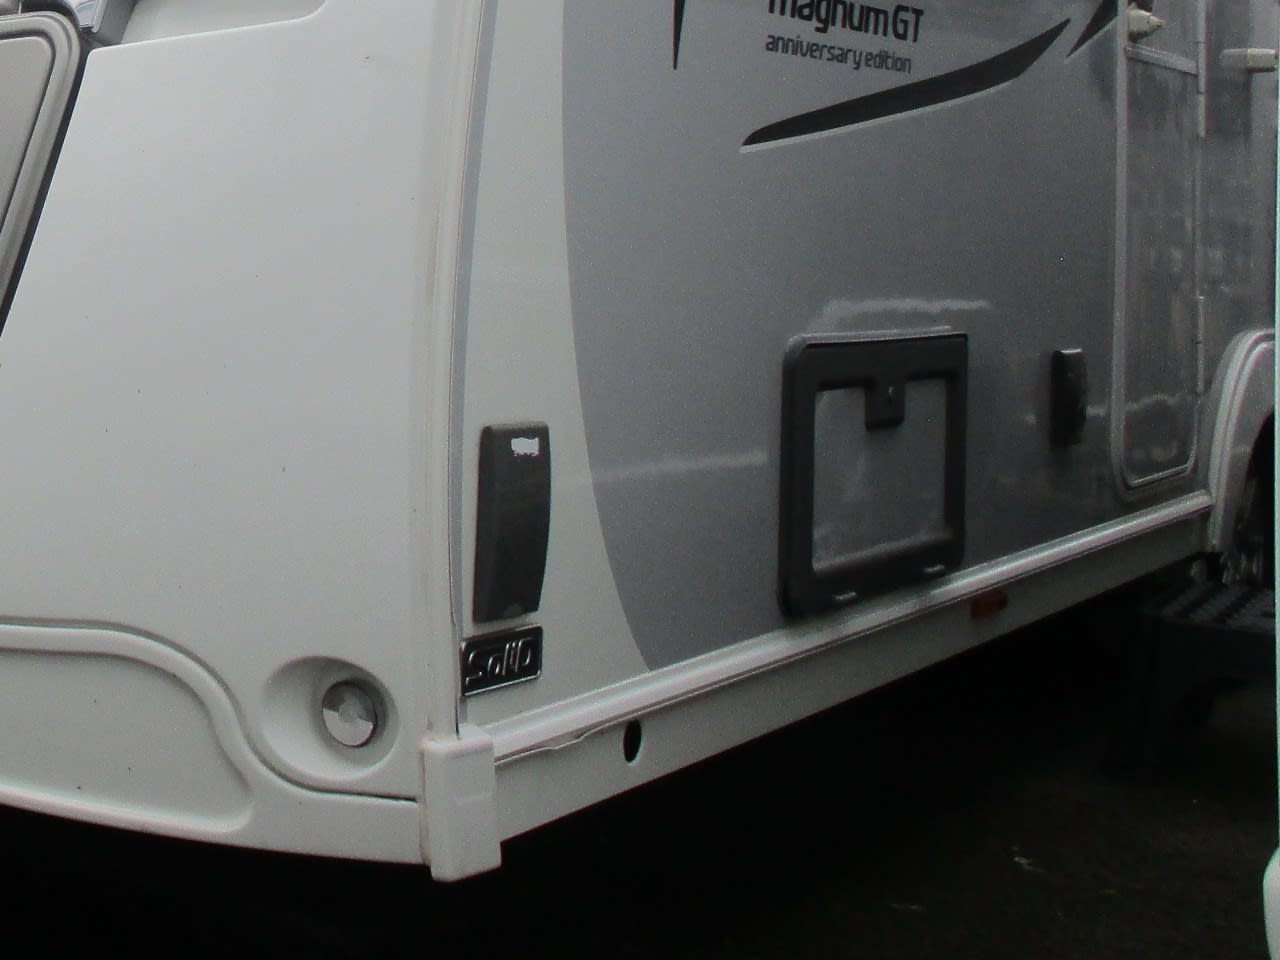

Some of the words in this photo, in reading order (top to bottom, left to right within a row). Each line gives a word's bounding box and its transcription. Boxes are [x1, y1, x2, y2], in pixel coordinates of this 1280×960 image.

[892, 4, 924, 43] GT
[766, 35, 862, 70] anniversary
[864, 50, 912, 74] edition
